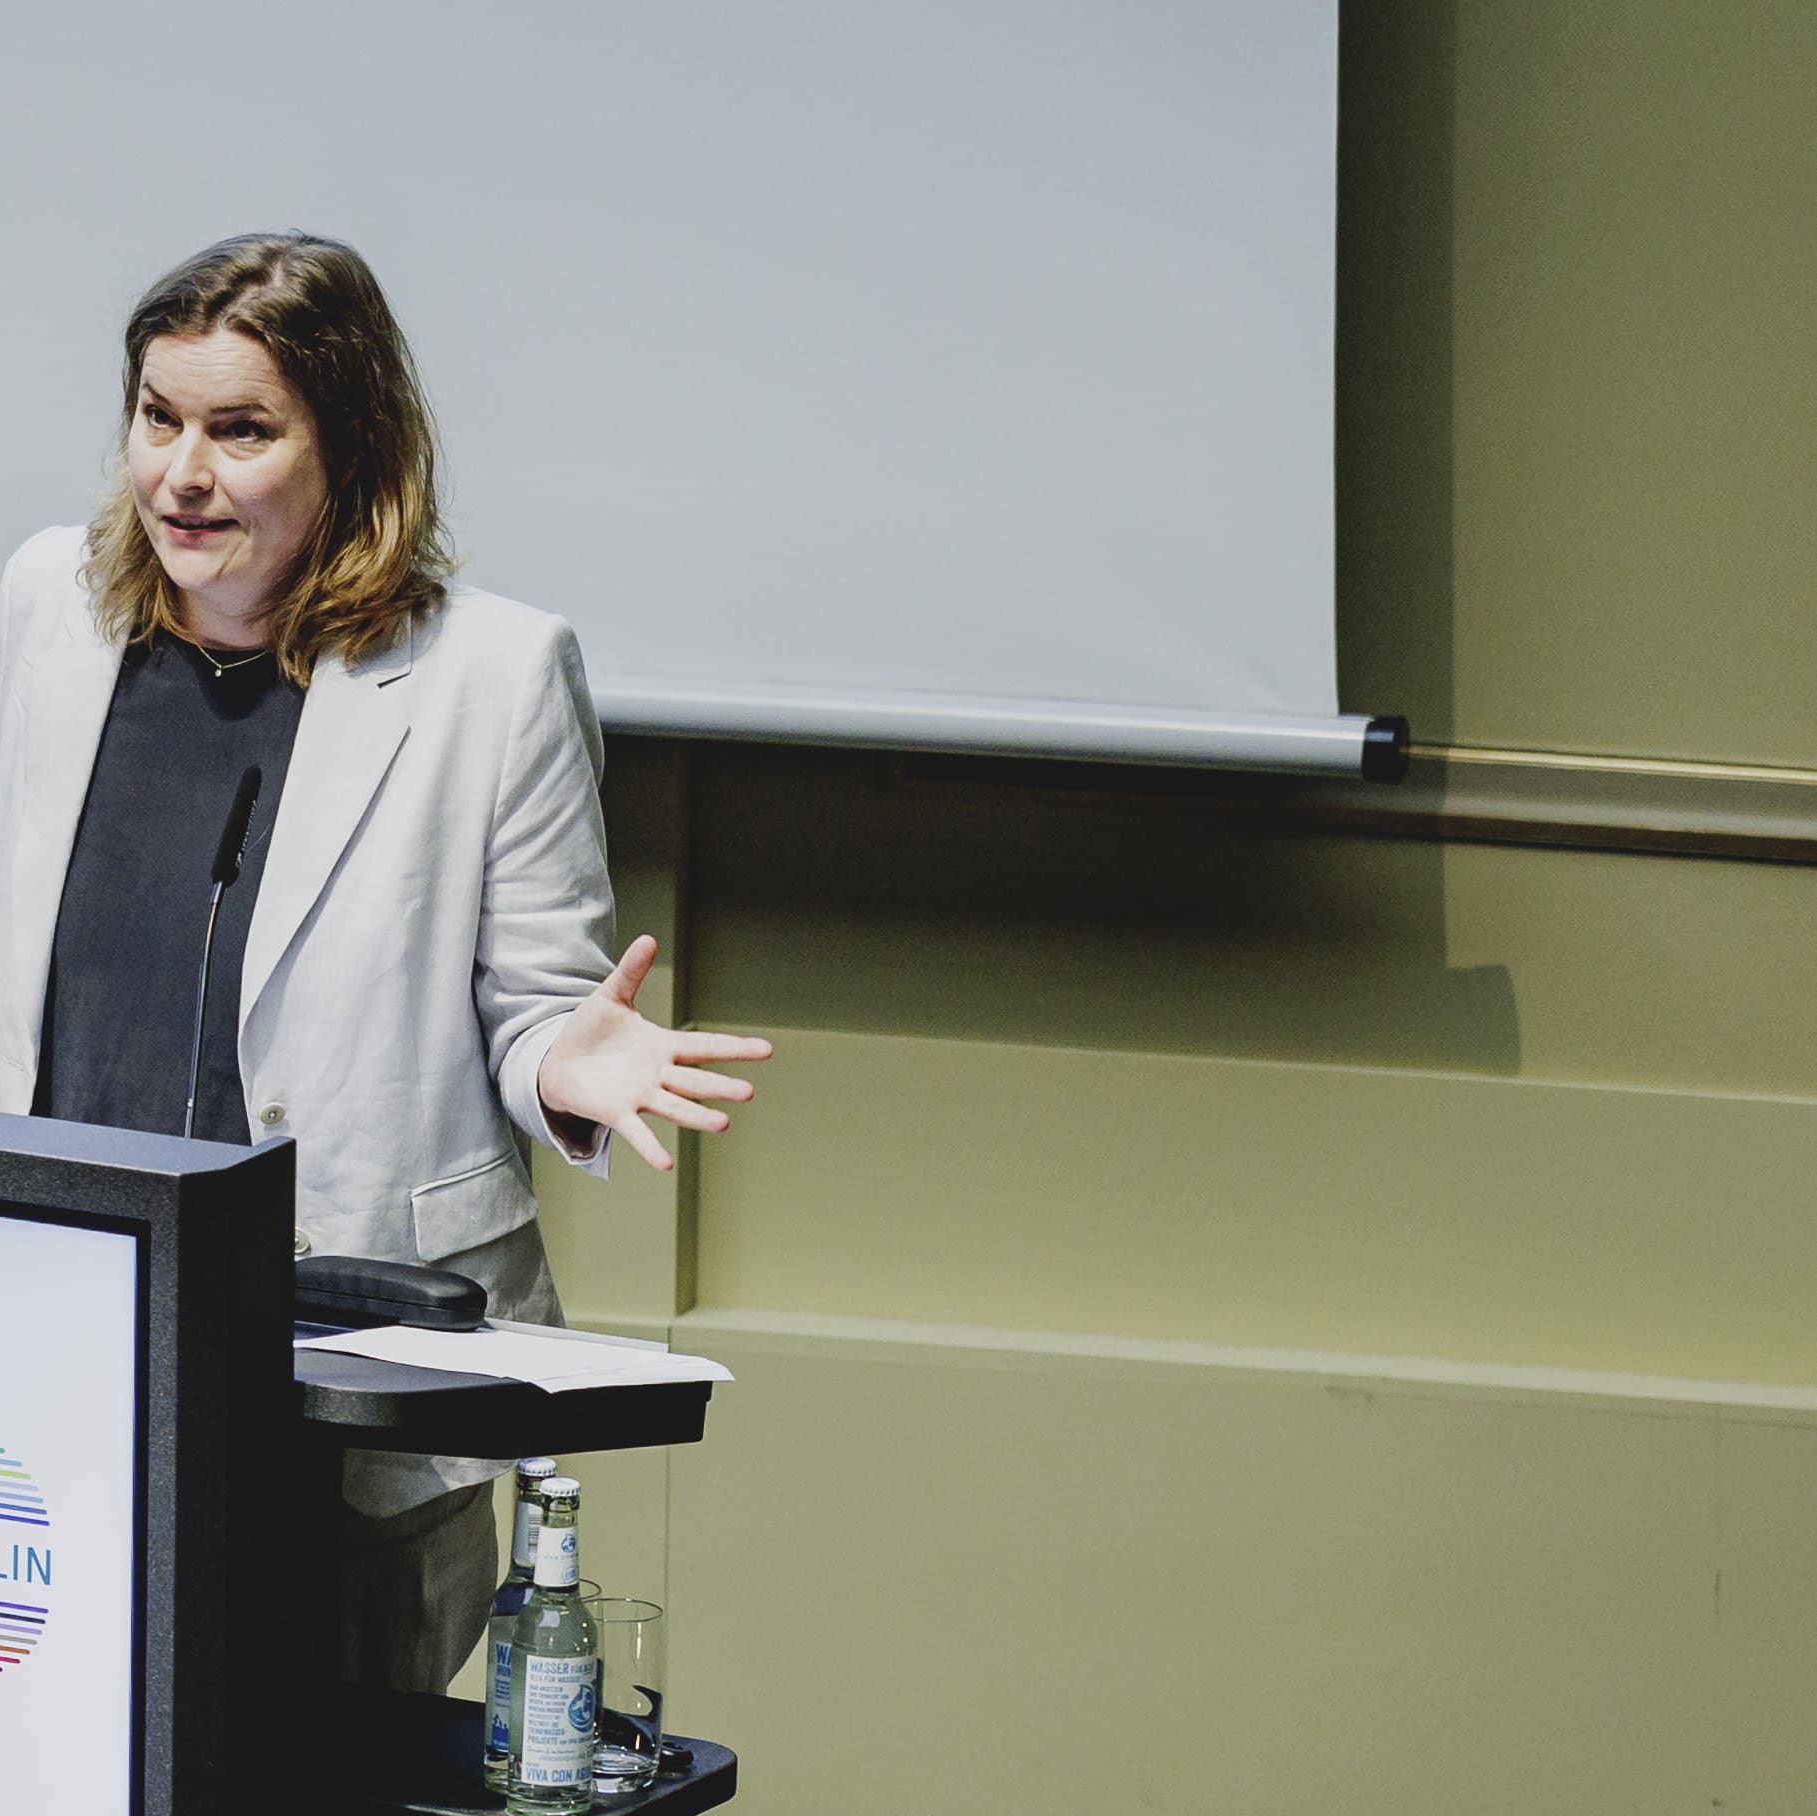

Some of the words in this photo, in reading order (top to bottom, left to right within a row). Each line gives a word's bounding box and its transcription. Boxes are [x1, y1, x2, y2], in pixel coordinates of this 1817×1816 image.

[531, 1662, 569, 1674] WASSER
[526, 1767, 548, 1782] VIVA
[551, 1768, 573, 1783] CON
